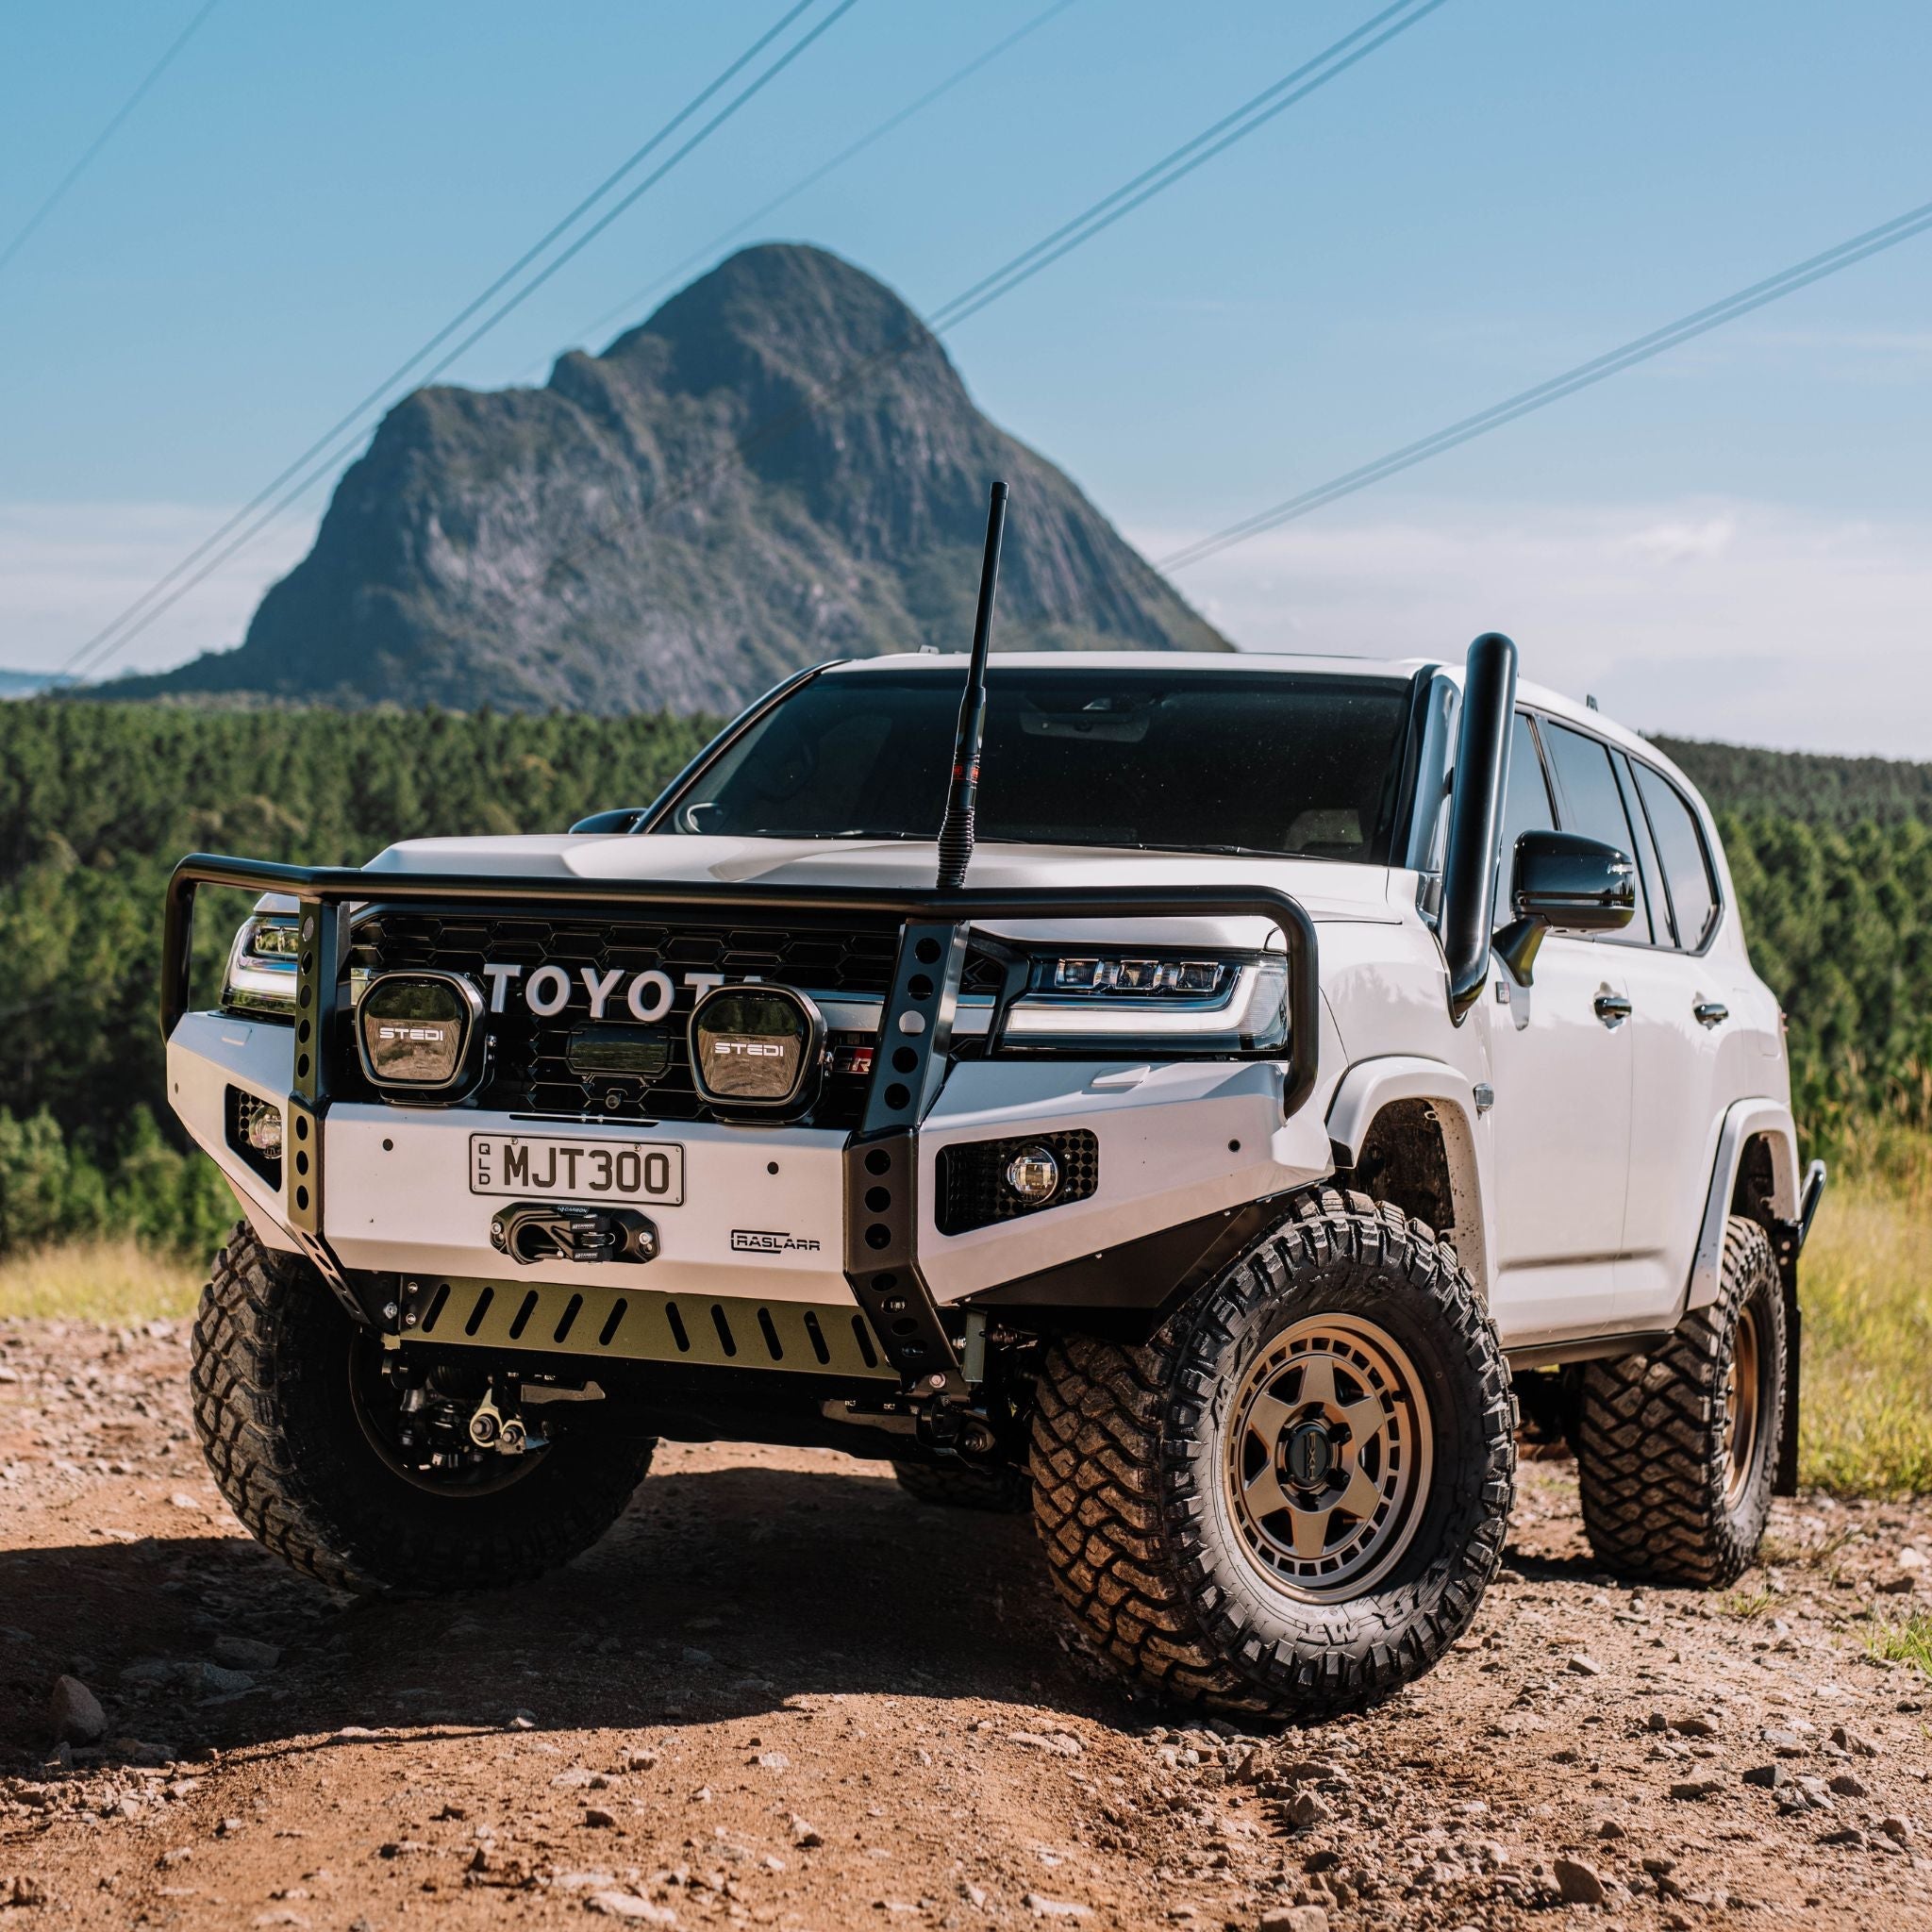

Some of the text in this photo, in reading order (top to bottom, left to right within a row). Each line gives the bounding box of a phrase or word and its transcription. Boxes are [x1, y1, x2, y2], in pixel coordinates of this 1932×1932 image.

[483, 963, 763, 1023] TOYOT
[379, 1027, 443, 1041] STEDI
[714, 1041, 784, 1057] STEDI
[504, 1144, 670, 1194] MJT300
[736, 1235, 821, 1251] RASLARR
